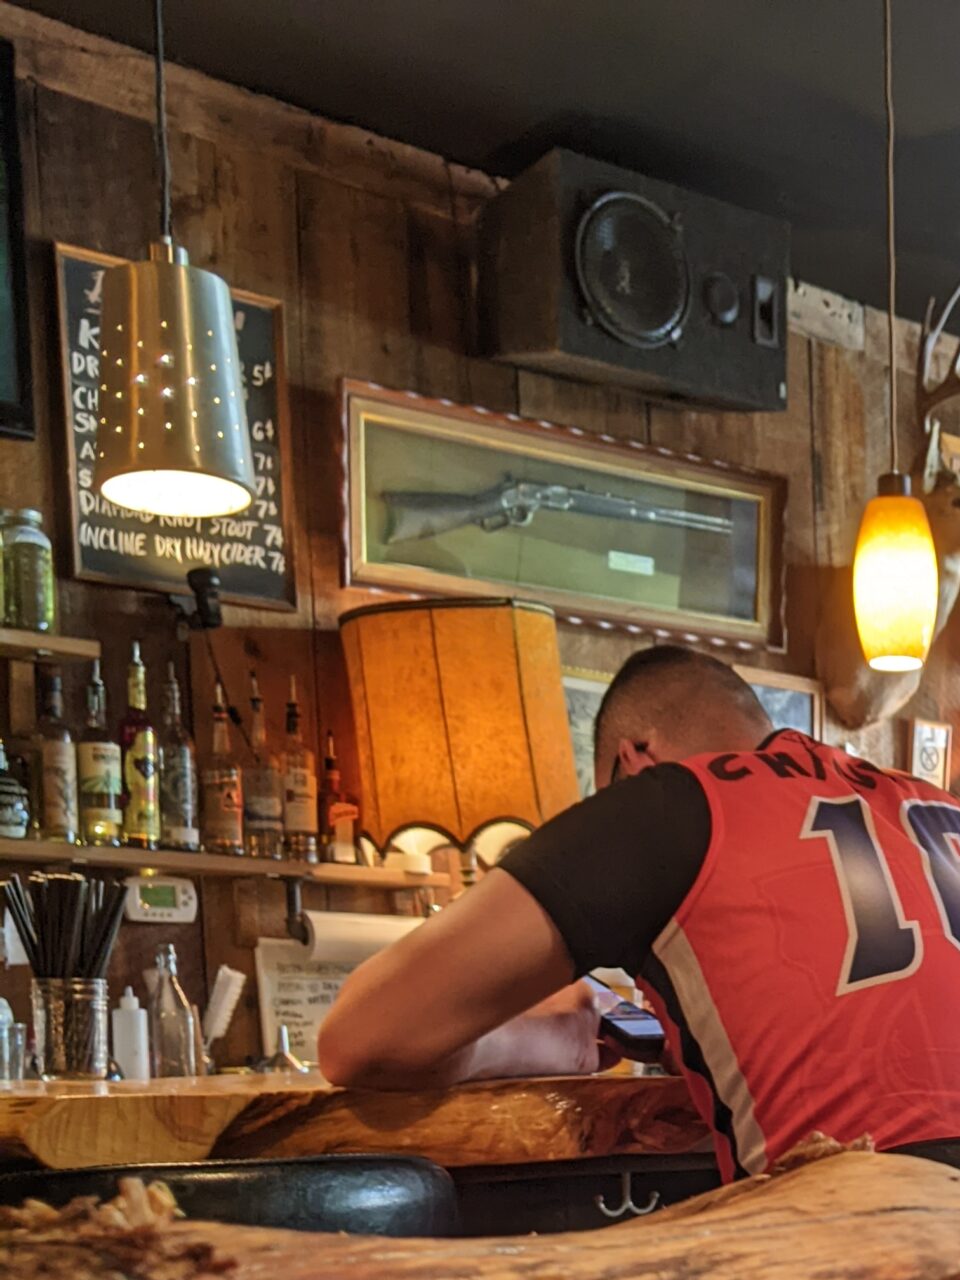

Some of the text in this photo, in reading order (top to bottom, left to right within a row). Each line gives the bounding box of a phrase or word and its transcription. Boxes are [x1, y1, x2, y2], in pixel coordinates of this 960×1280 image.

[209, 517, 259, 540] STOUT
[154, 534, 183, 564] DRY
[221, 543, 267, 569] CIDER
